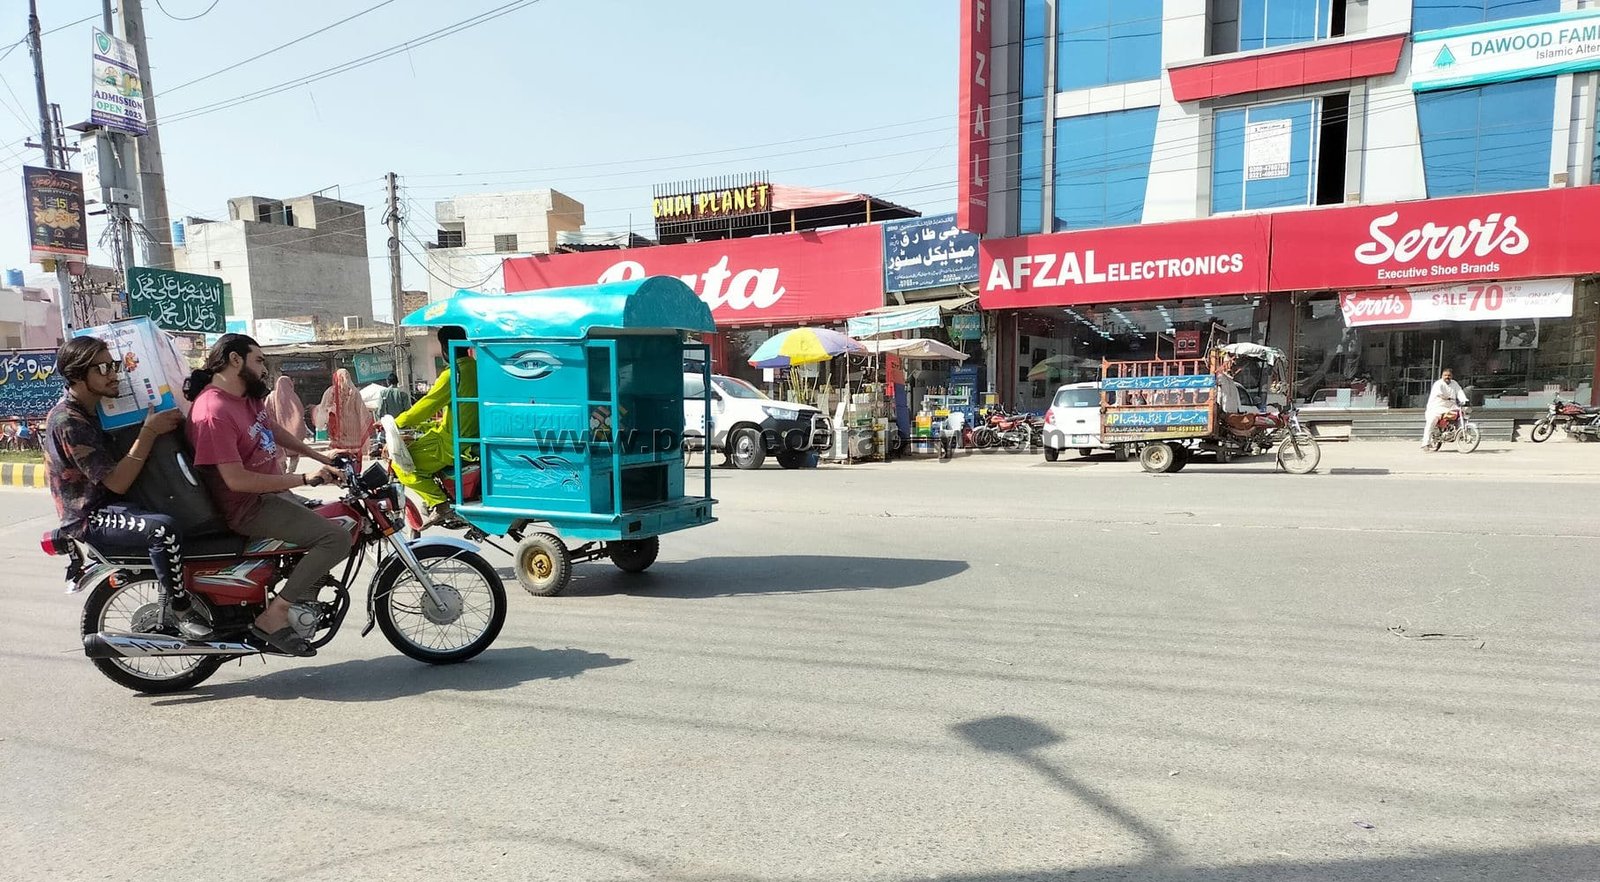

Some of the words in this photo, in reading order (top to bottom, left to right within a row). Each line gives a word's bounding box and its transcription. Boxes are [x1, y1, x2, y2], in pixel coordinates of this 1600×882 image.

[1471, 32, 1552, 56] DAWOOD
[1536, 47, 1573, 59] Islamic
[94, 90, 143, 110] ADMISSION
[96, 101, 122, 114] OPEN
[124, 109, 143, 120] 2023
[653, 195, 692, 218] CHAI
[698, 185, 769, 215] PLANET
[1355, 211, 1529, 265] Servis
[986, 250, 1106, 291] AFZAL
[1107, 253, 1244, 282] ELECTRONICS
[1377, 266, 1428, 280] Executive
[1430, 264, 1458, 276] Shoe
[1461, 262, 1500, 274] Brands
[1343, 292, 1404, 317] Servis
[1432, 293, 1466, 306] SALE
[1467, 285, 1503, 311] 70
[1107, 413, 1123, 424] API
